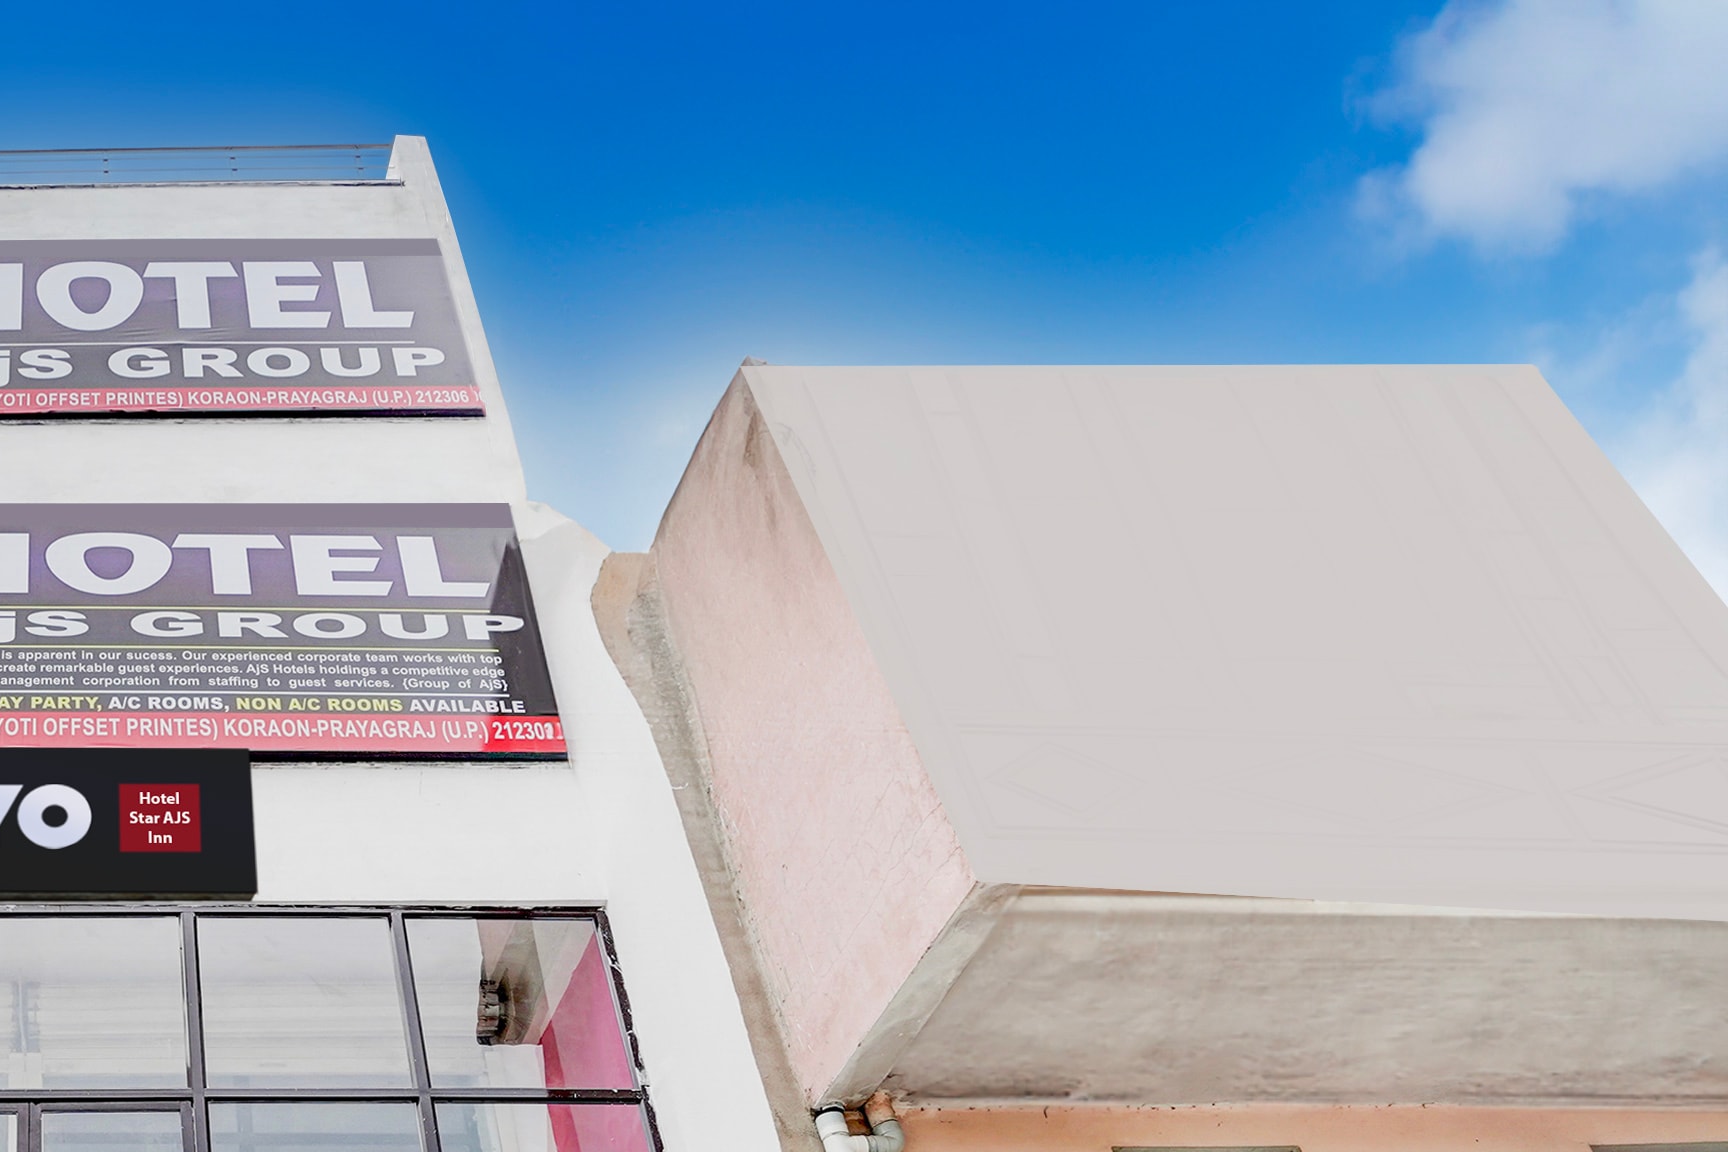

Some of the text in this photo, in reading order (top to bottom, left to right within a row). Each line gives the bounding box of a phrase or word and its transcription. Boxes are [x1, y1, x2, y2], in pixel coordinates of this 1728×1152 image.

[107, 344, 446, 379] GROUP
[35, 392, 101, 407] OFFSET
[106, 391, 183, 409] PRINTES)
[188, 389, 368, 406] KORAON-PRAYAGRAJ
[372, 389, 412, 408] (U.P.)
[415, 390, 469, 403] 212306
[128, 611, 525, 641] GROUP
[1, 650, 12, 660] is
[17, 650, 76, 662] apparent
[81, 650, 93, 660] in
[99, 652, 121, 660] our
[126, 652, 176, 660] sucess.
[182, 651, 206, 660] Our
[211, 651, 292, 663] experienced
[297, 653, 361, 664] corporate
[365, 654, 398, 663] team
[403, 654, 443, 663] works
[448, 654, 475, 663] with
[480, 655, 502, 665] top
[40, 663, 114, 673] remarkable
[118, 664, 155, 675] guest
[159, 664, 243, 675] experiences.
[246, 664, 269, 675] AjS
[273, 665, 315, 674] Hotels
[319, 665, 377, 676] holdings
[380, 667, 389, 675] a
[392, 666, 469, 677] competitive
[472, 667, 505, 678] edge
[82, 676, 160, 687] corporation
[168, 676, 200, 686] from
[208, 676, 259, 688] staffing
[267, 677, 280, 687] to
[288, 678, 326, 688] guest
[334, 678, 394, 688] services.
[458, 679, 472, 689] of
[30, 696, 102, 712] PARTY,
[108, 696, 141, 710] A/C
[148, 697, 229, 712] ROOMS,
[236, 698, 281, 710] NON
[288, 698, 321, 711] A/C
[327, 698, 403, 712] ROOMS
[410, 699, 526, 713] AVAILABLE
[43, 718, 120, 736] OFFSET
[126, 718, 219, 741] PRINTES)
[224, 719, 436, 739] KORAON-PRAYAGRAJ
[442, 721, 489, 743] (U.P.)
[139, 792, 180, 805] Hotel
[129, 811, 191, 825] Star AJS
[148, 831, 173, 844] Inn
